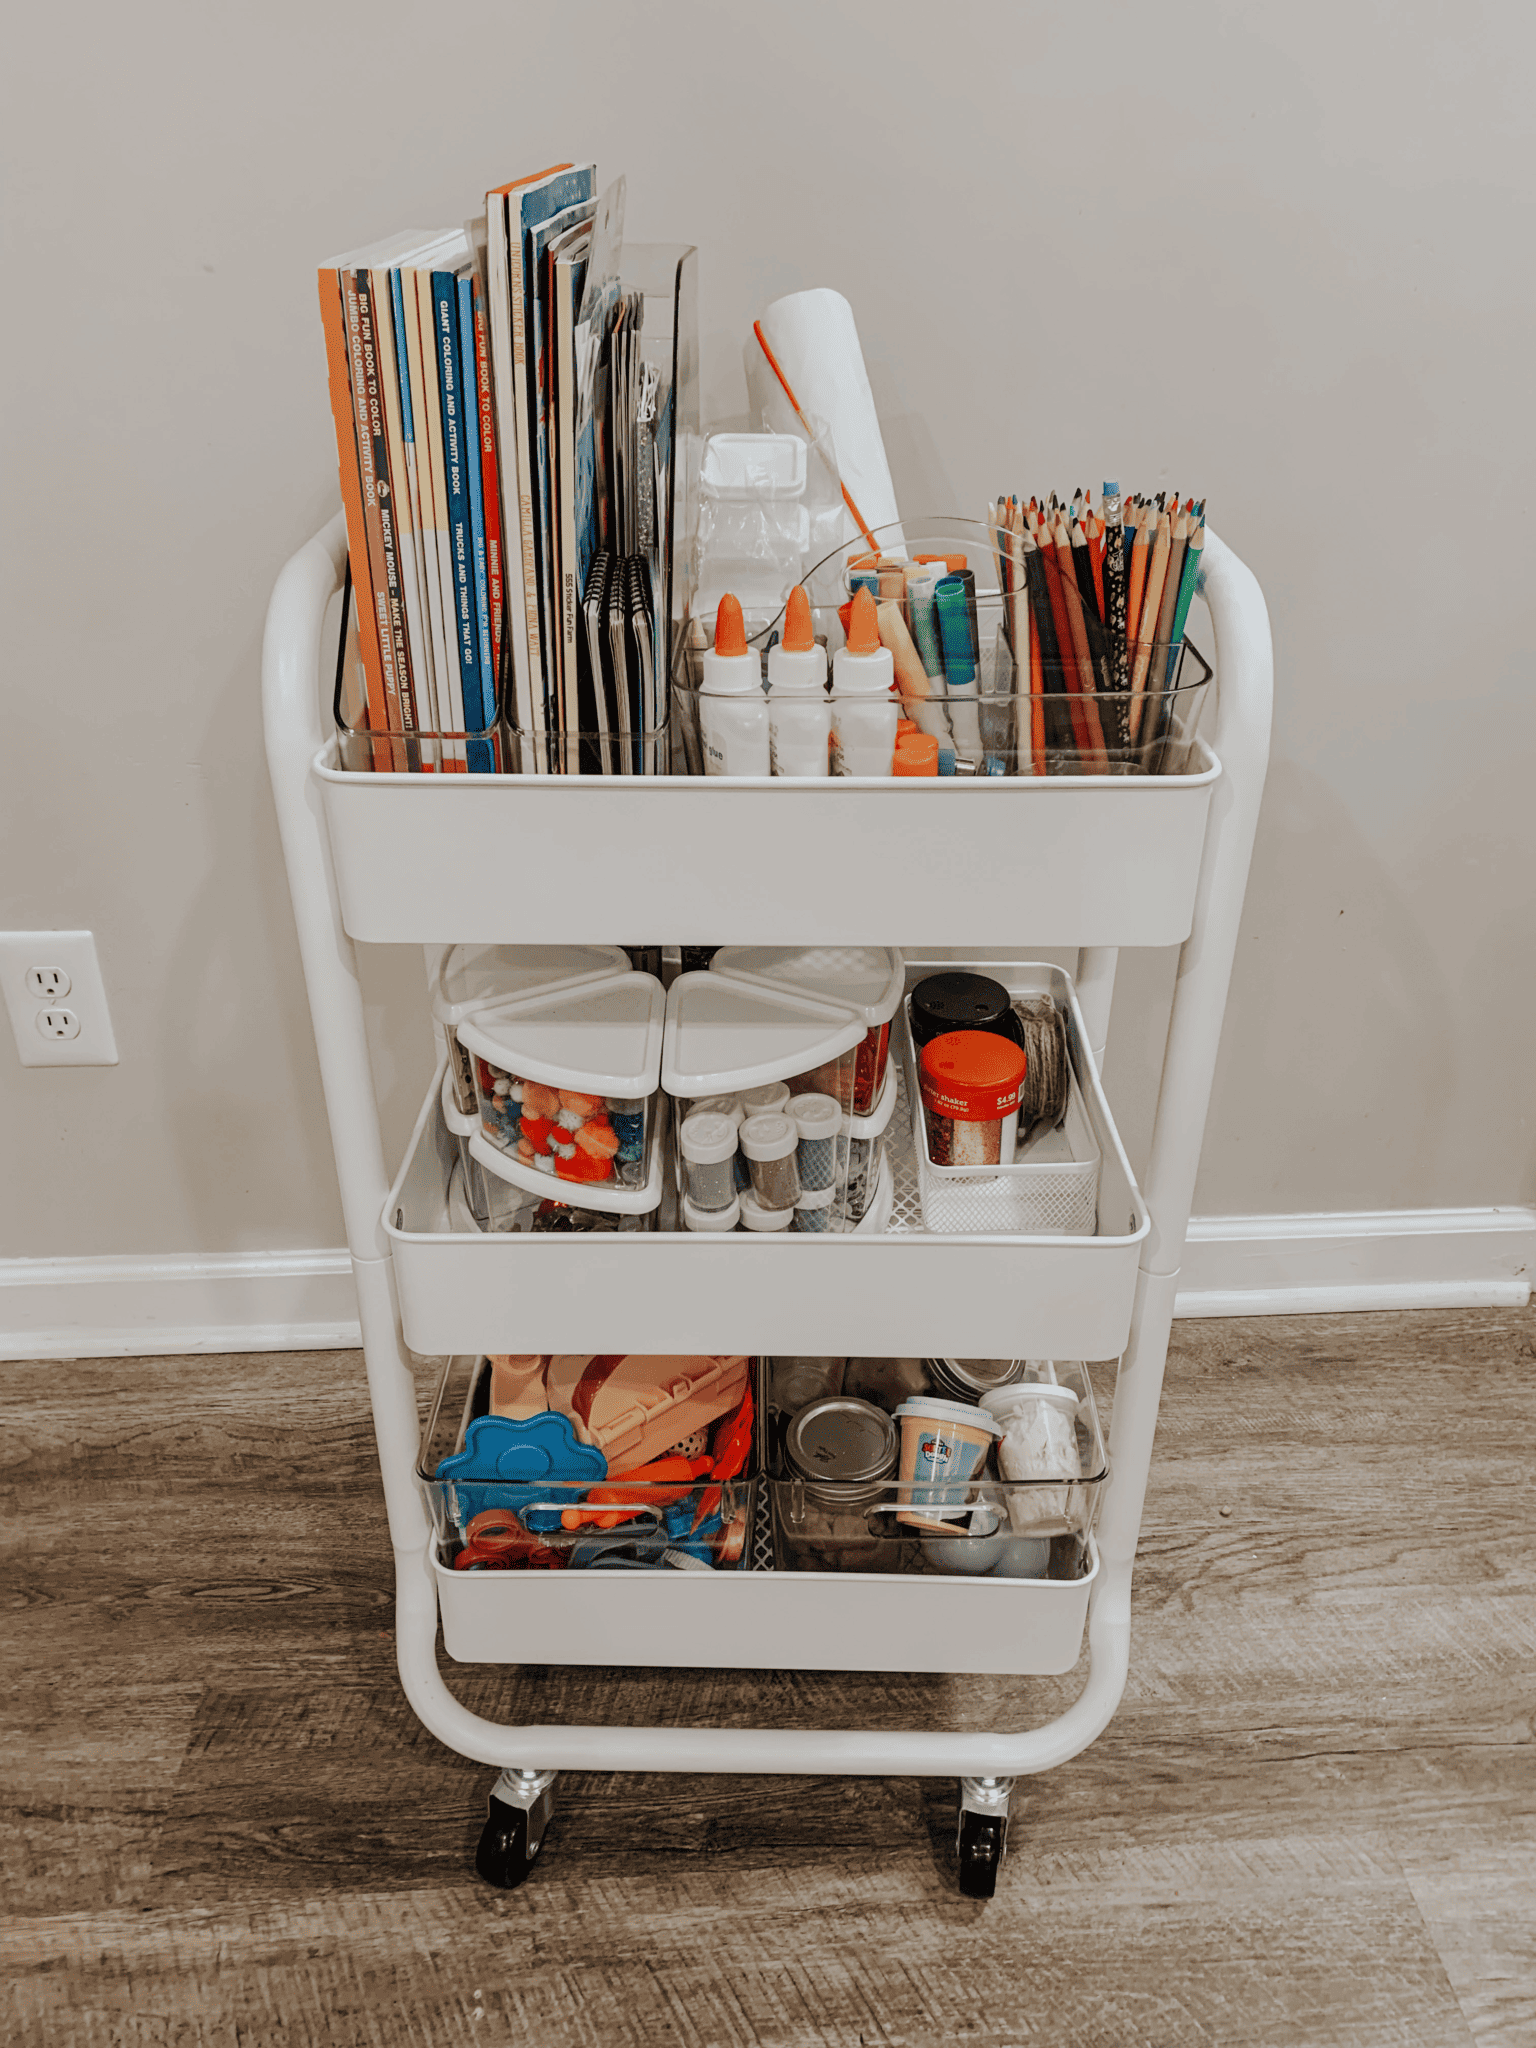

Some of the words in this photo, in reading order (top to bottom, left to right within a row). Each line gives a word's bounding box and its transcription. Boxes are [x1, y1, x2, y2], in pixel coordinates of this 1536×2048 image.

[511, 242, 522, 294] UNICORNS
[348, 289, 360, 332] JUMBO
[358, 293, 369, 314] BIG
[440, 300, 450, 333] GIANT
[512, 296, 524, 338] STICKER
[360, 317, 372, 341] FUN
[364, 344, 376, 377] BOOK
[478, 333, 487, 358] FUN
[514, 342, 525, 365] BOOK
[352, 335, 366, 395] COLORING
[442, 336, 454, 391] COLORING
[479, 360, 490, 393] BOOK
[368, 379, 377, 395] TO
[357, 397, 368, 422] AND
[370, 397, 382, 436] COLOR
[446, 393, 456, 416] AND
[482, 395, 491, 412] TO
[360, 423, 373, 473] ACTIVITY
[448, 418, 459, 464] ACTIVITY
[482, 414, 493, 453] COLOR
[365, 475, 377, 507] BOOK
[451, 466, 461, 495] BOOK
[381, 509, 393, 550] MICKEY
[521, 494, 532, 536] CAMILLA
[455, 522, 466, 561] TRUCKS
[489, 539, 499, 576] MINNIE
[386, 551, 397, 587] MOUSE
[458, 562, 467, 583] AND
[565, 573, 573, 586] 555
[459, 586, 470, 620] THINGS
[480, 580, 488, 612] COLORING
[491, 577, 501, 600] AND
[566, 588, 574, 612] Sticker
[377, 591, 388, 625] SWEET
[391, 598, 402, 627] MAKE
[492, 601, 502, 644] FRIENDS
[527, 604, 538, 630] FIONA
[380, 627, 392, 661] LITTLE
[393, 629, 405, 648] THE
[462, 622, 472, 646] THAT
[529, 633, 540, 657] WATT
[396, 650, 409, 689] SEASON
[465, 648, 473, 665] GO!
[385, 663, 397, 695] PUPPY
[401, 692, 413, 729] BRIGHT!
[708, 746, 724, 761] glue
[940, 1094, 968, 1106] shaker
[997, 1091, 1016, 1106] $4.99
